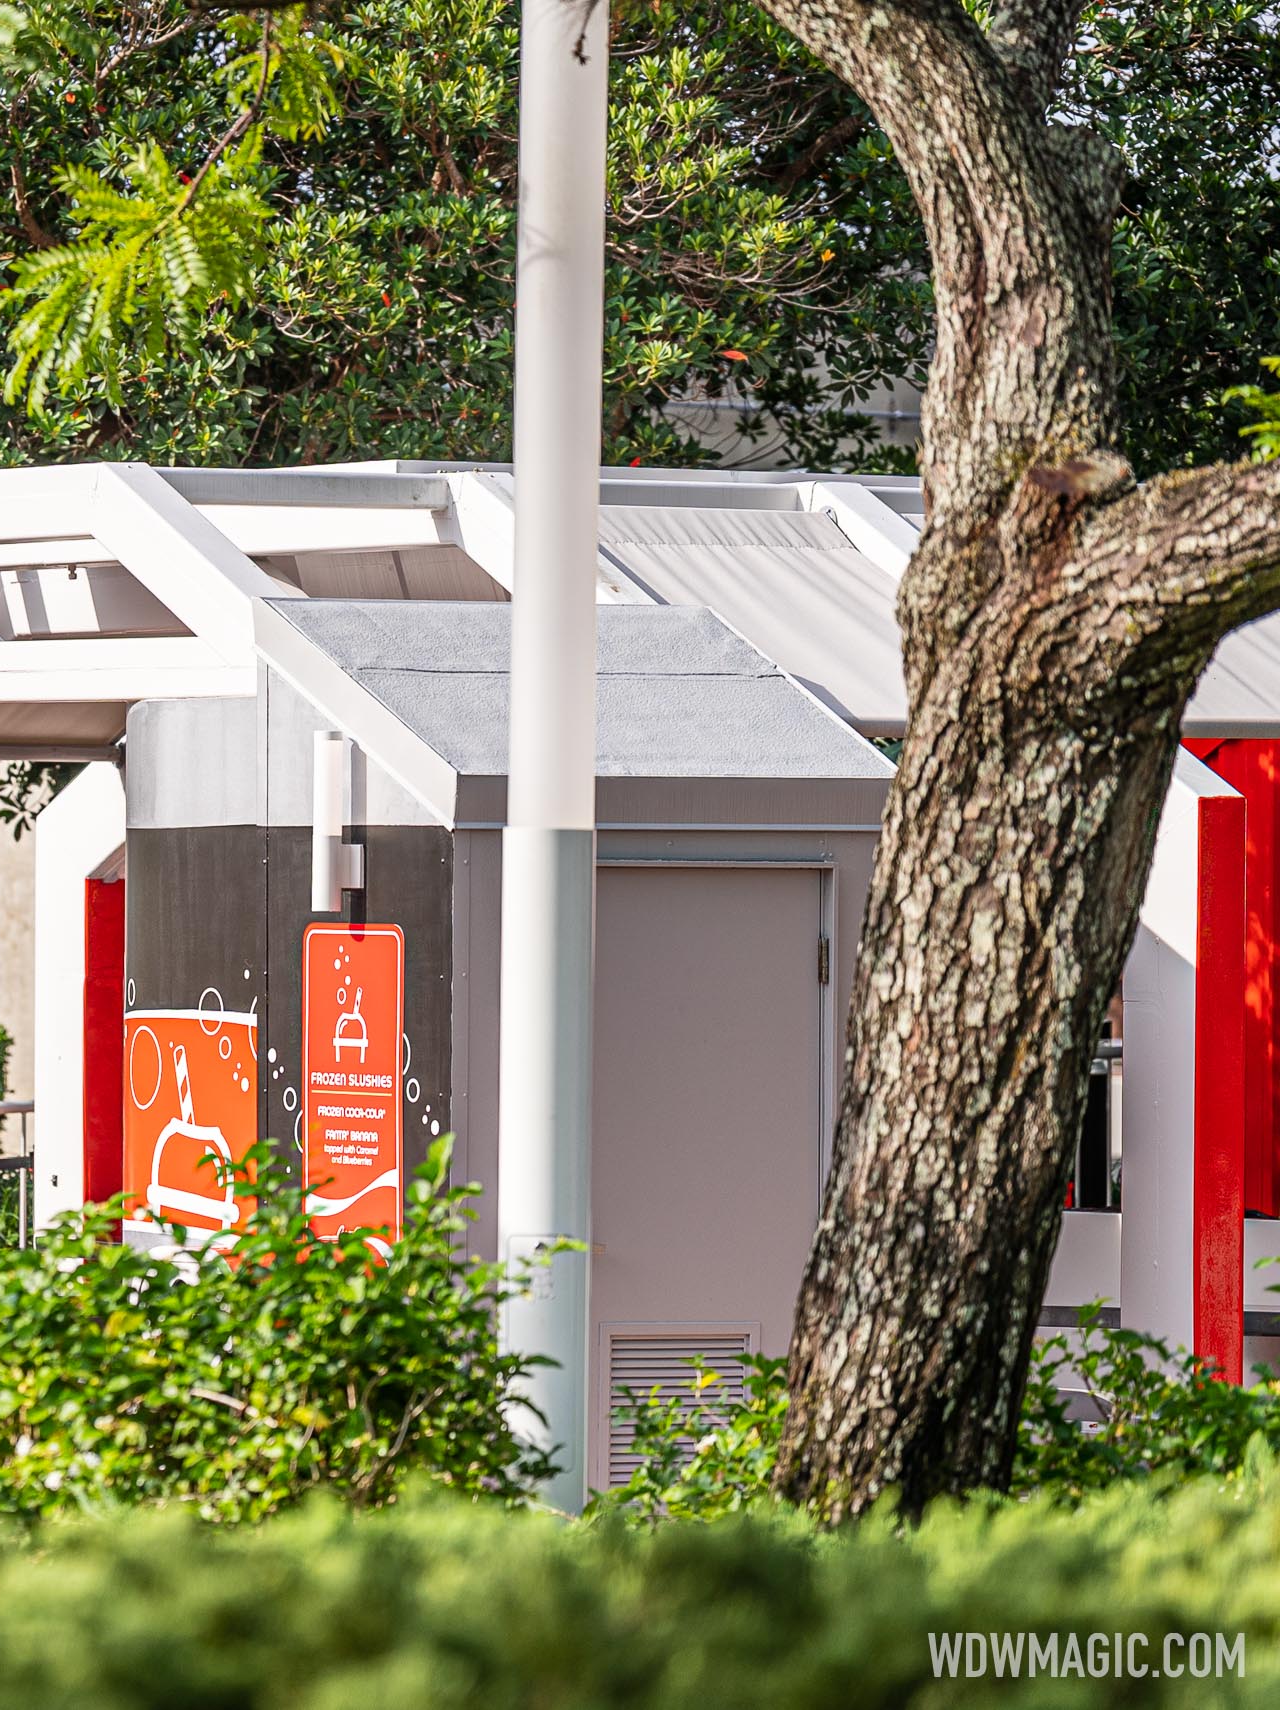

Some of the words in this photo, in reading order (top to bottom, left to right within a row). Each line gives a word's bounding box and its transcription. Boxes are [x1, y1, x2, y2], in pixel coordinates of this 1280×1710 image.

[311, 1072, 346, 1086] FROZEN
[348, 1073, 393, 1088] SLUSHIES
[317, 1105, 344, 1117] FROZEN
[350, 1130, 378, 1142] BANANA
[324, 1144, 343, 1154] topped
[344, 1144, 355, 1154] with
[356, 1145, 378, 1155] Caramel
